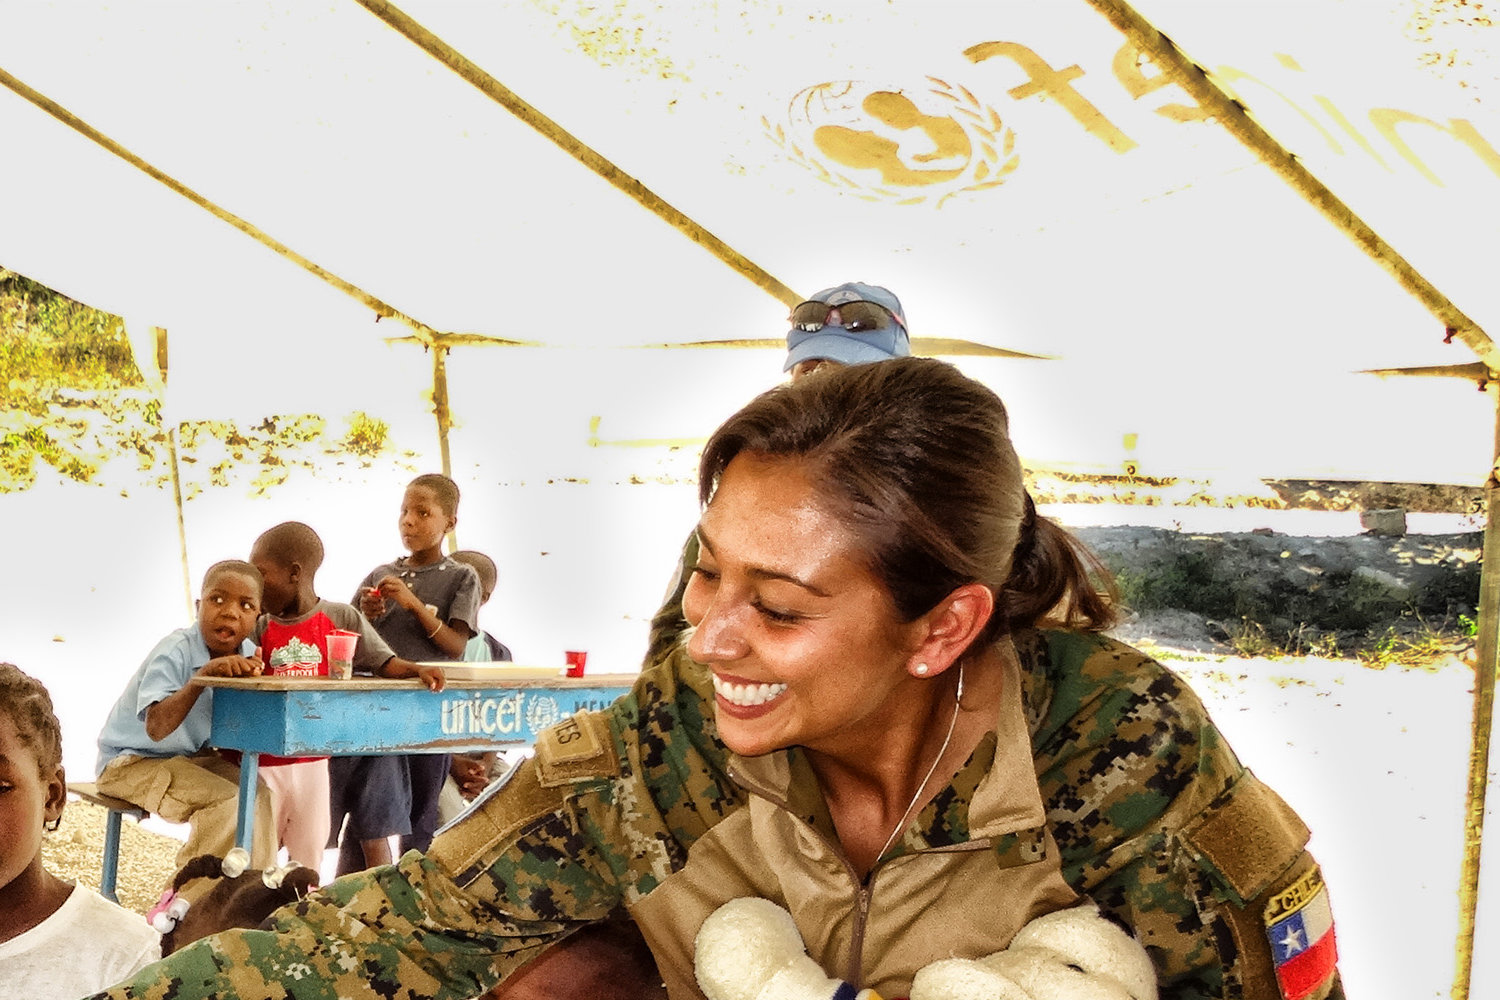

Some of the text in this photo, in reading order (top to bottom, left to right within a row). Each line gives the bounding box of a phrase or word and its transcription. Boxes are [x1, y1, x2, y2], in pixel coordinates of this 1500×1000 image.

[440, 692, 525, 734] unicef
[553, 717, 581, 744] TES
[1281, 876, 1318, 911] CHILE
